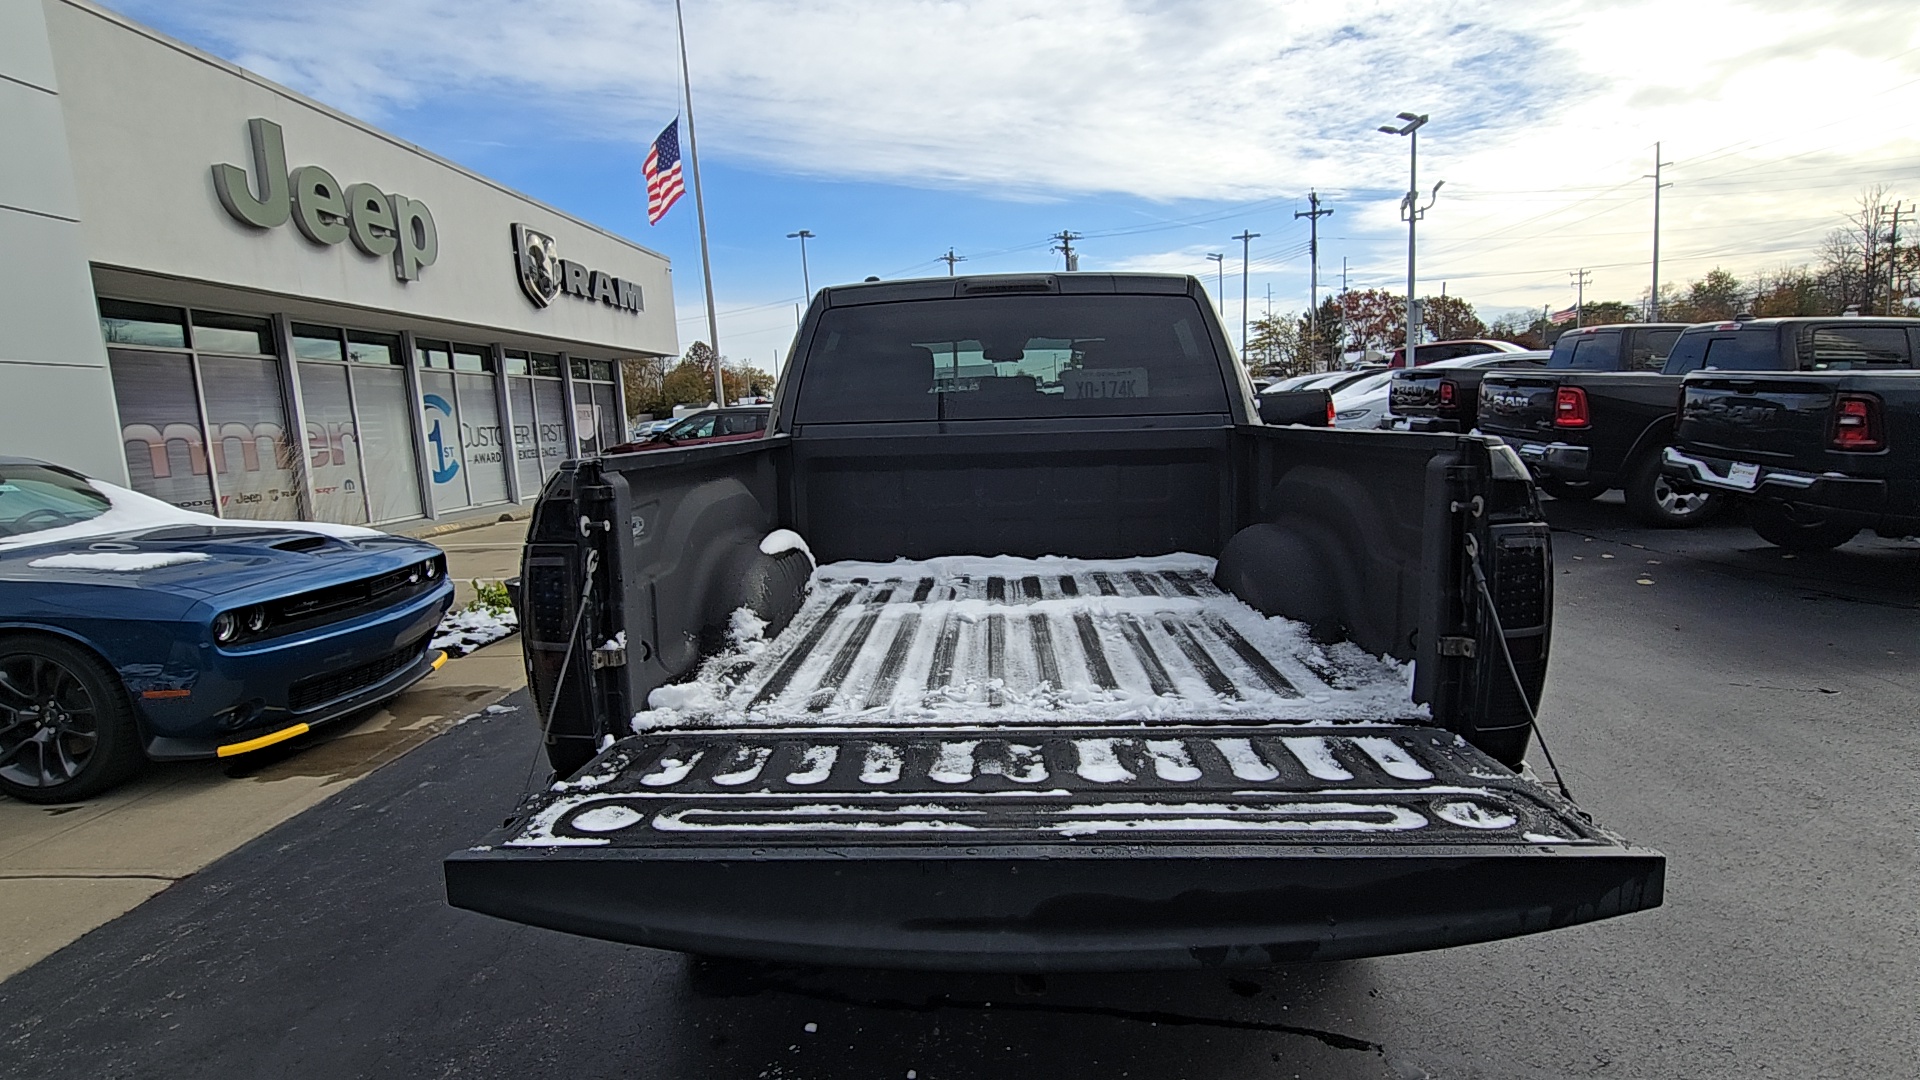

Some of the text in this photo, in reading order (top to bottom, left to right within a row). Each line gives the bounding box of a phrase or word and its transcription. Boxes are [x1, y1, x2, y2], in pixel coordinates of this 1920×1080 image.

[211, 117, 438, 282] Jeep
[559, 258, 645, 314] RAM
[1493, 395, 1529, 407] RAM
[1709, 403, 1777, 420] RAM
[462, 422, 530, 448] CUSTOER
[473, 446, 558, 465] AWARD EXCELENCE
[235, 492, 263, 504] Jeep
[314, 486, 339, 495] SRT
